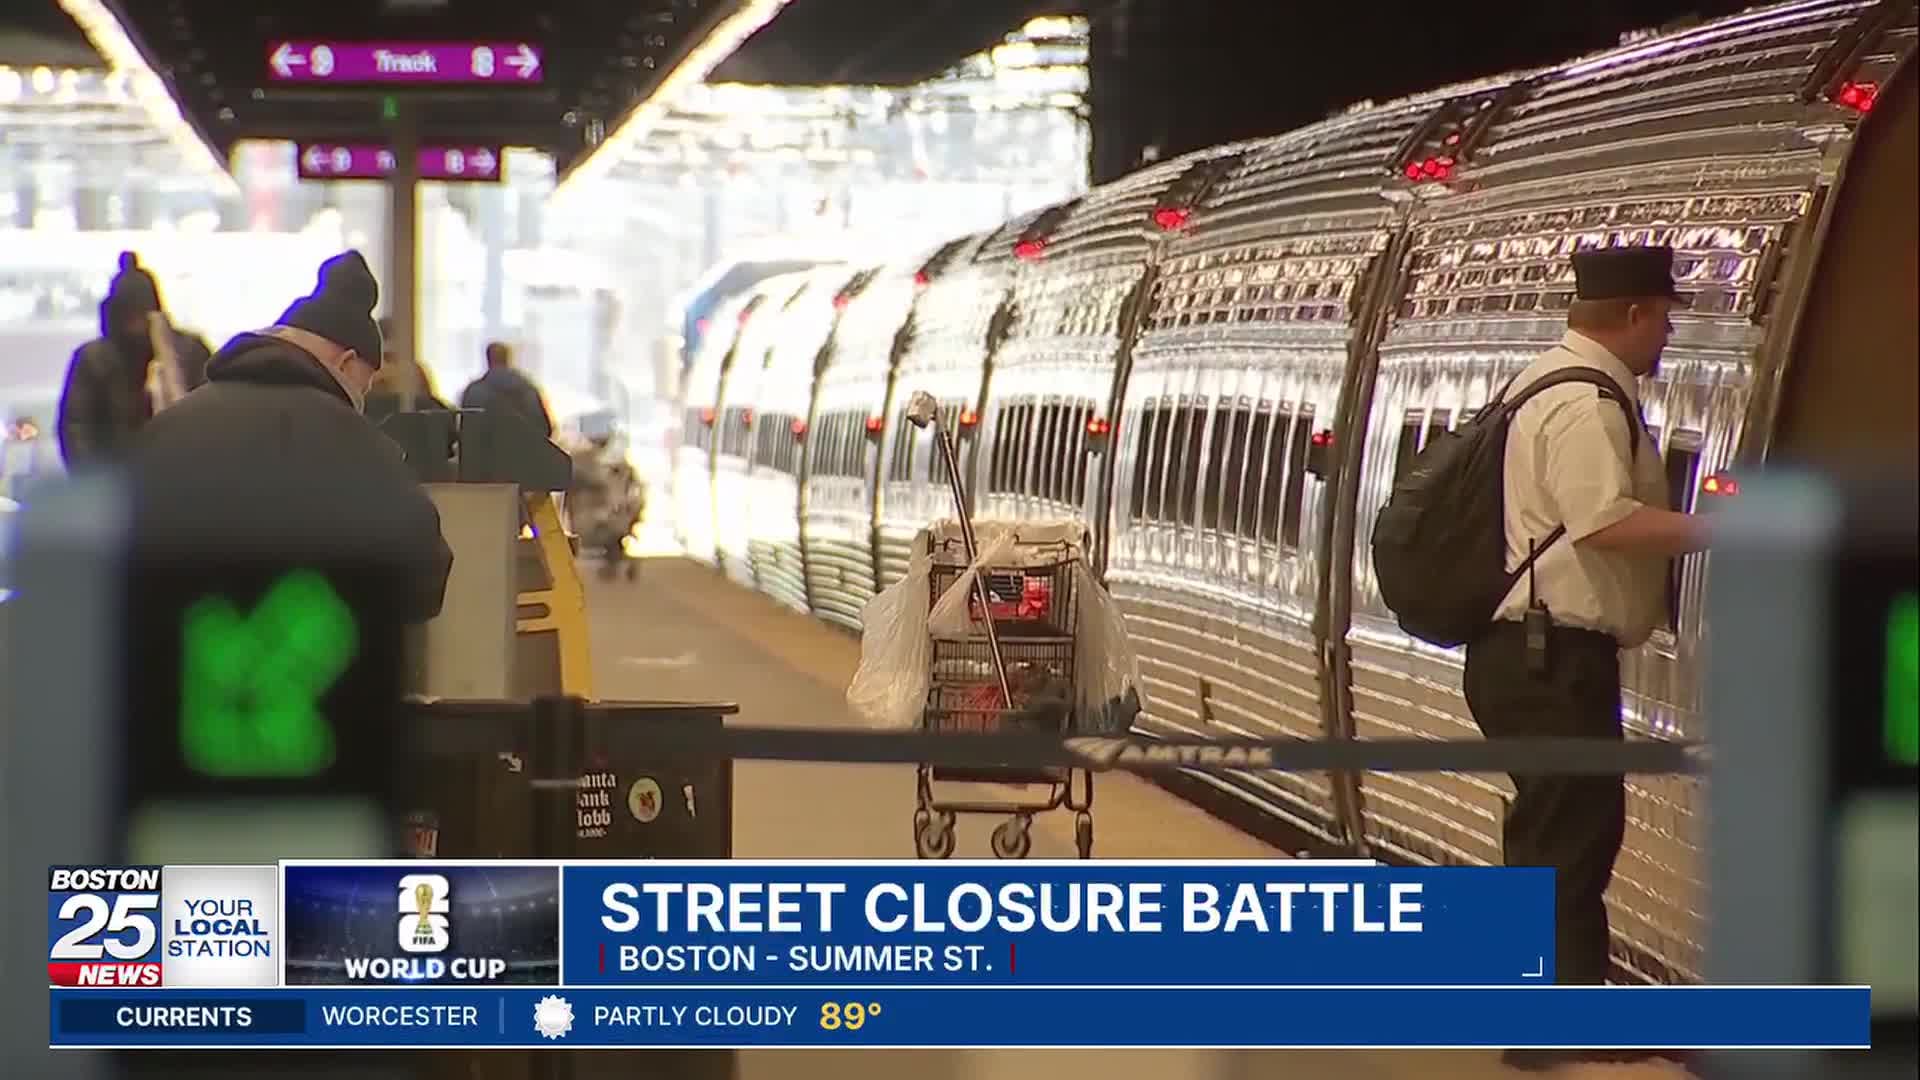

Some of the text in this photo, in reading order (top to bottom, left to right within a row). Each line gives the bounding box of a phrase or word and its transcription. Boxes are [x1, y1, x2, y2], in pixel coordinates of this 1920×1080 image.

[310, 45, 335, 76] 9
[373, 49, 438, 73] Track
[1117, 744, 1273, 767] AMTRAK
